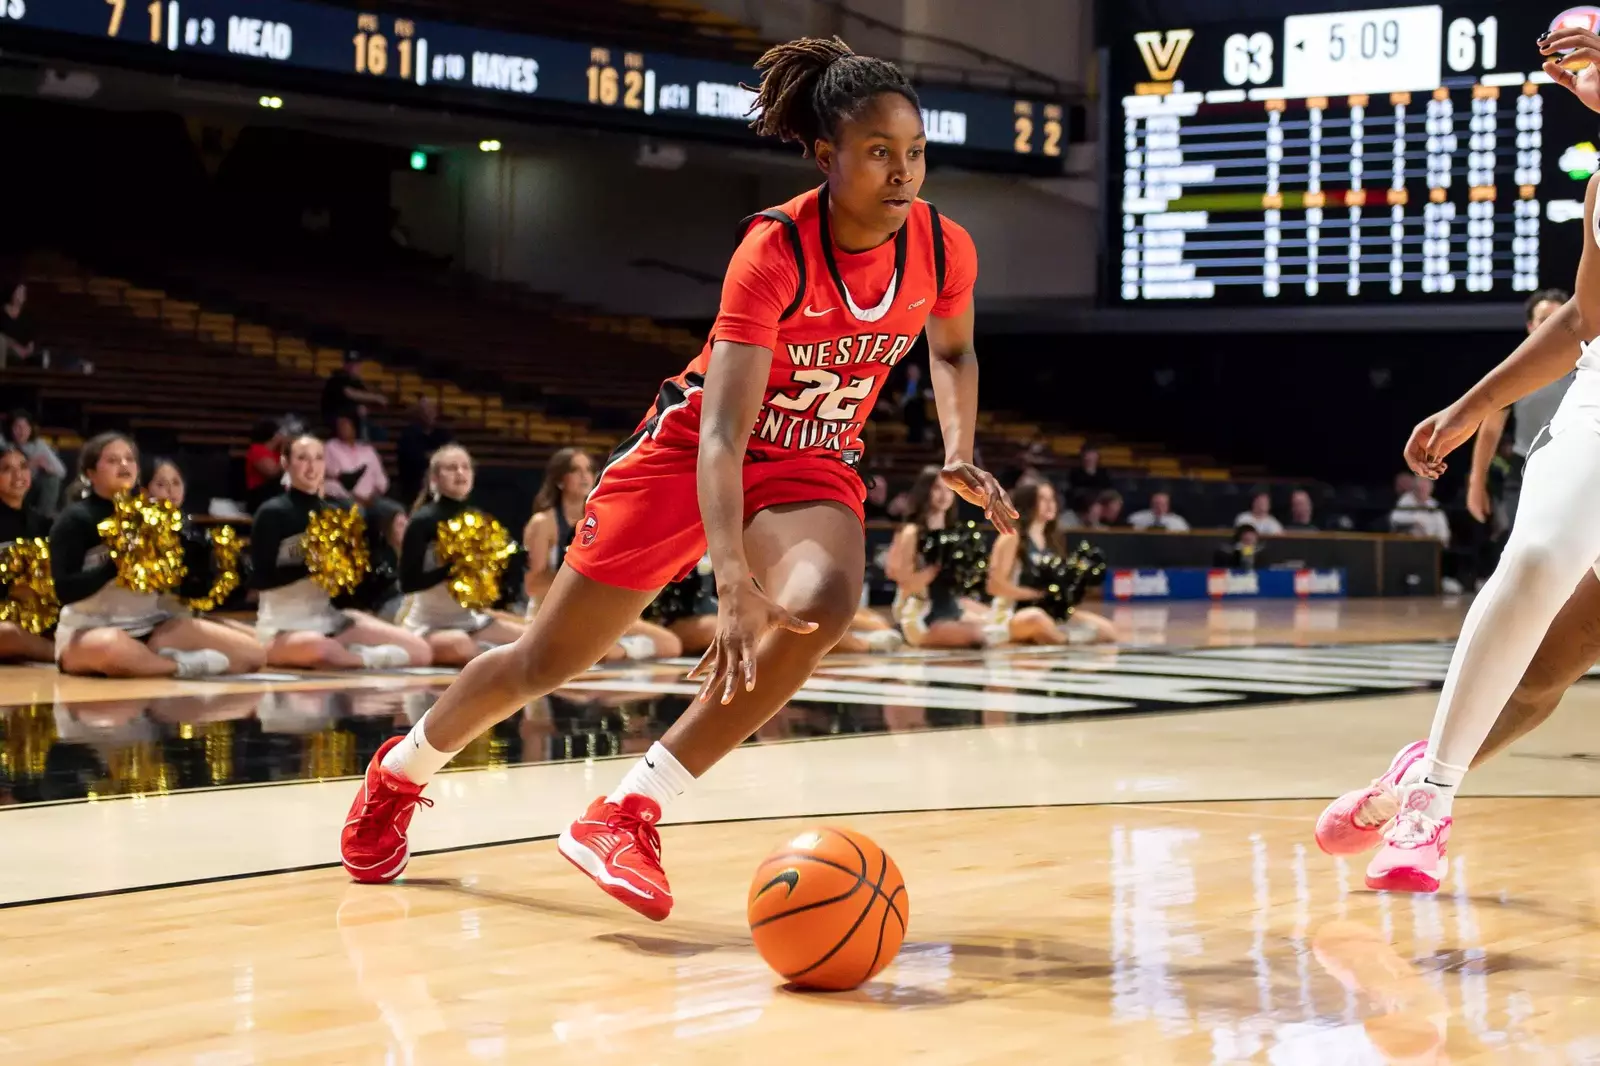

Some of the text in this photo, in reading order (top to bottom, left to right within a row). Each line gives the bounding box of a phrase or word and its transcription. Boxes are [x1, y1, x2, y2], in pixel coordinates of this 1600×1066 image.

[227, 15, 292, 60] MEAD
[353, 32, 388, 76] 16
[397, 38, 412, 80] 1
[1133, 29, 1195, 80] V
[1223, 32, 1274, 85] 63
[1447, 16, 1498, 72] 61
[471, 51, 539, 93] HAYES
[586, 64, 619, 106] 16
[623, 69, 643, 109] 2
[1014, 117, 1033, 154] 2
[1043, 121, 1062, 157] 2
[769, 369, 875, 420] 32
